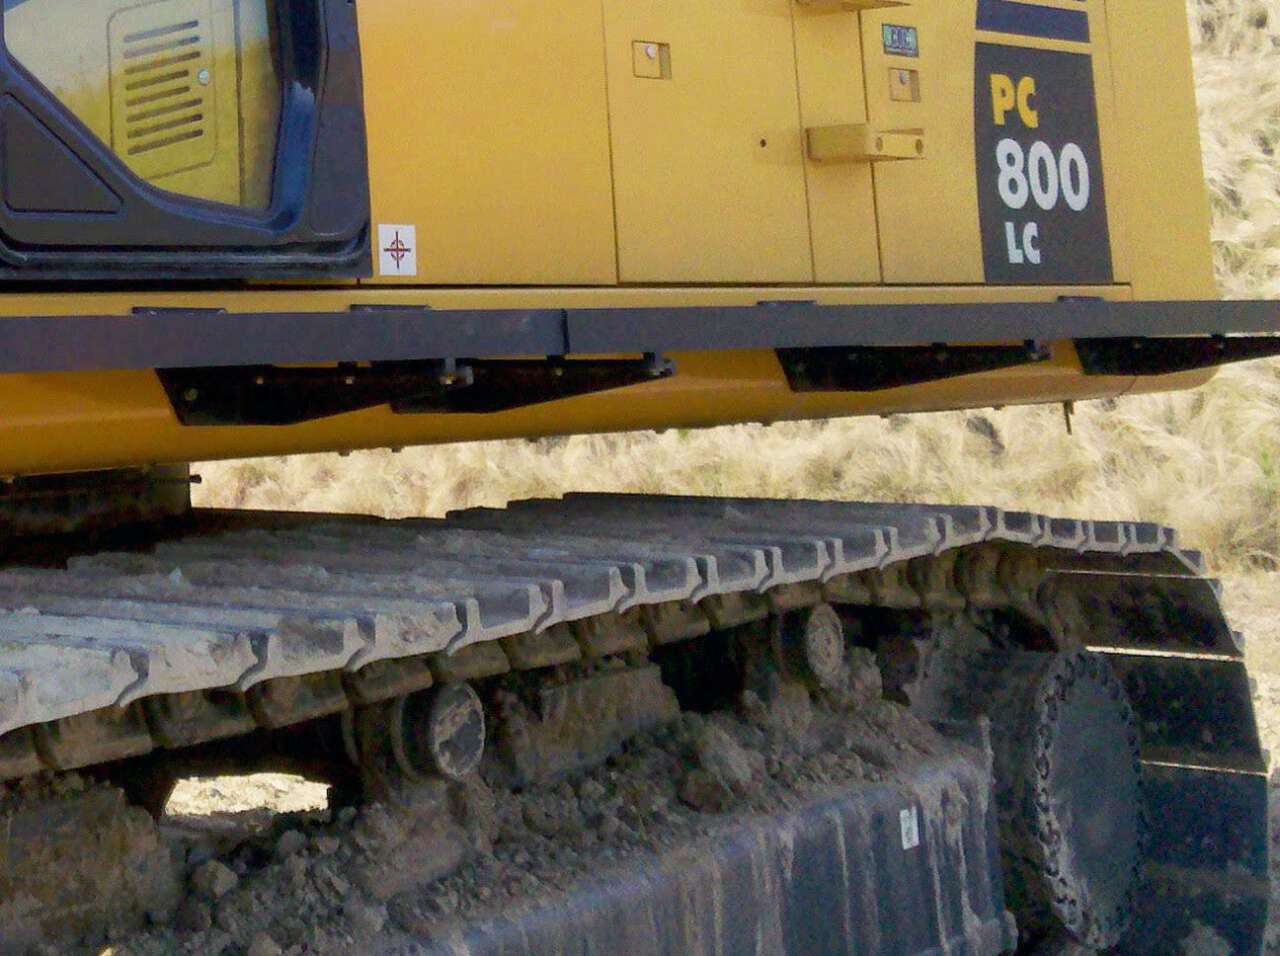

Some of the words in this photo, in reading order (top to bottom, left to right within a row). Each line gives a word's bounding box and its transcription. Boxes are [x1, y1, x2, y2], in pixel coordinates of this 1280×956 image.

[990, 73, 1039, 128] PC
[996, 138, 1090, 211] 800
[1004, 221, 1041, 264] LC
